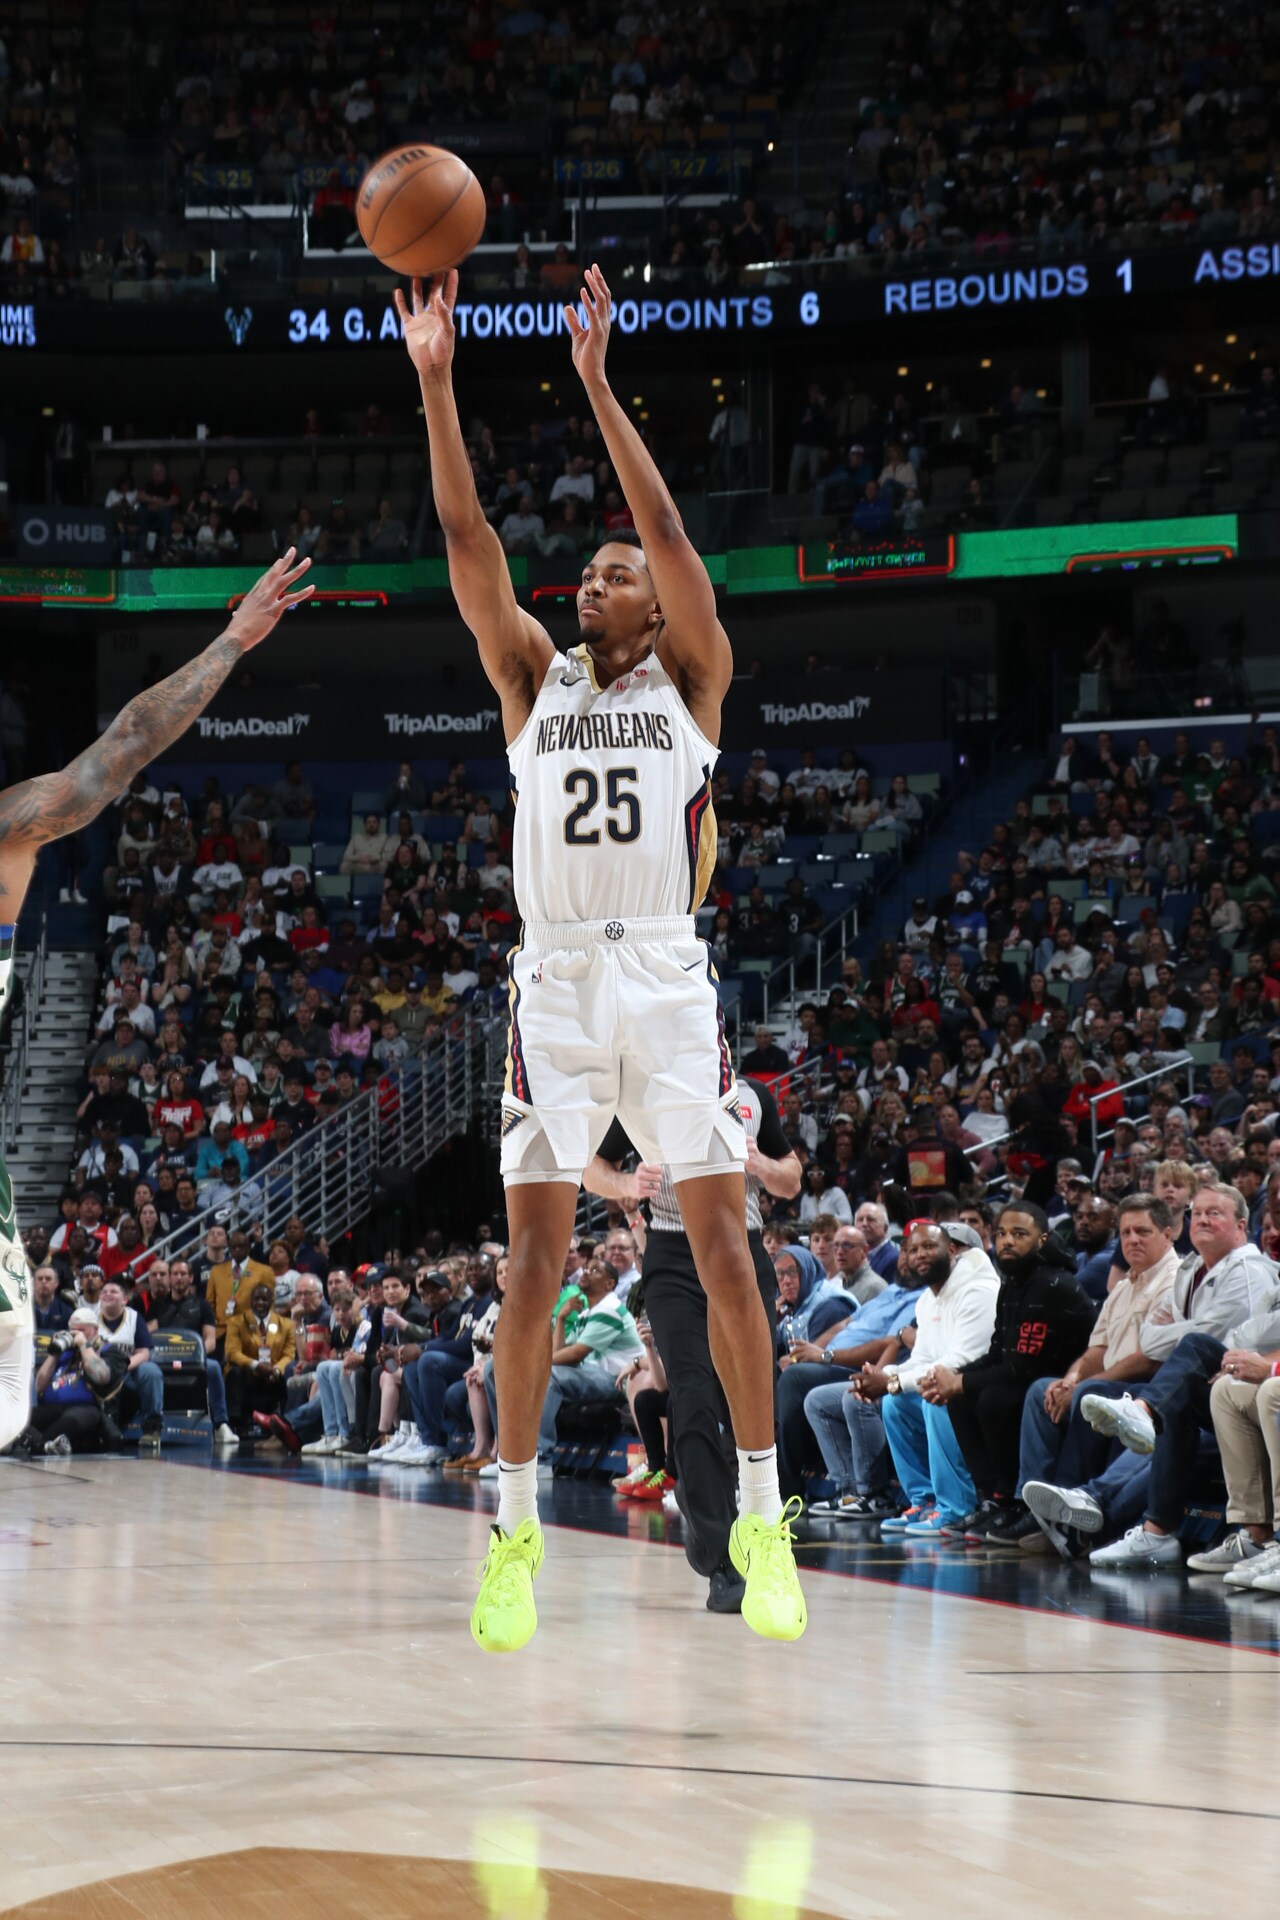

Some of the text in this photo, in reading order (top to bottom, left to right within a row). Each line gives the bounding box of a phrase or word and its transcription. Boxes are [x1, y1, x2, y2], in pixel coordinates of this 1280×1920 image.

[580, 159, 621, 179] 326
[288, 308, 330, 343] 34
[343, 307, 371, 341] G.
[379, 300, 640, 341] ATOKOUNO
[641, 296, 773, 331] POINTS
[800, 291, 820, 325] 6
[885, 265, 1089, 314] REBOUNDS
[1116, 259, 1132, 293] 1
[0, 325, 36, 346] UTS
[56, 523, 106, 542] HUB
[384, 712, 482, 736] TripADeal
[761, 699, 855, 726] TripADeal
[197, 716, 294, 740] TripADeal
[536, 711, 673, 756] NEW ORLEANS
[563, 766, 644, 847] 25
[788, 913, 799, 934] 3
